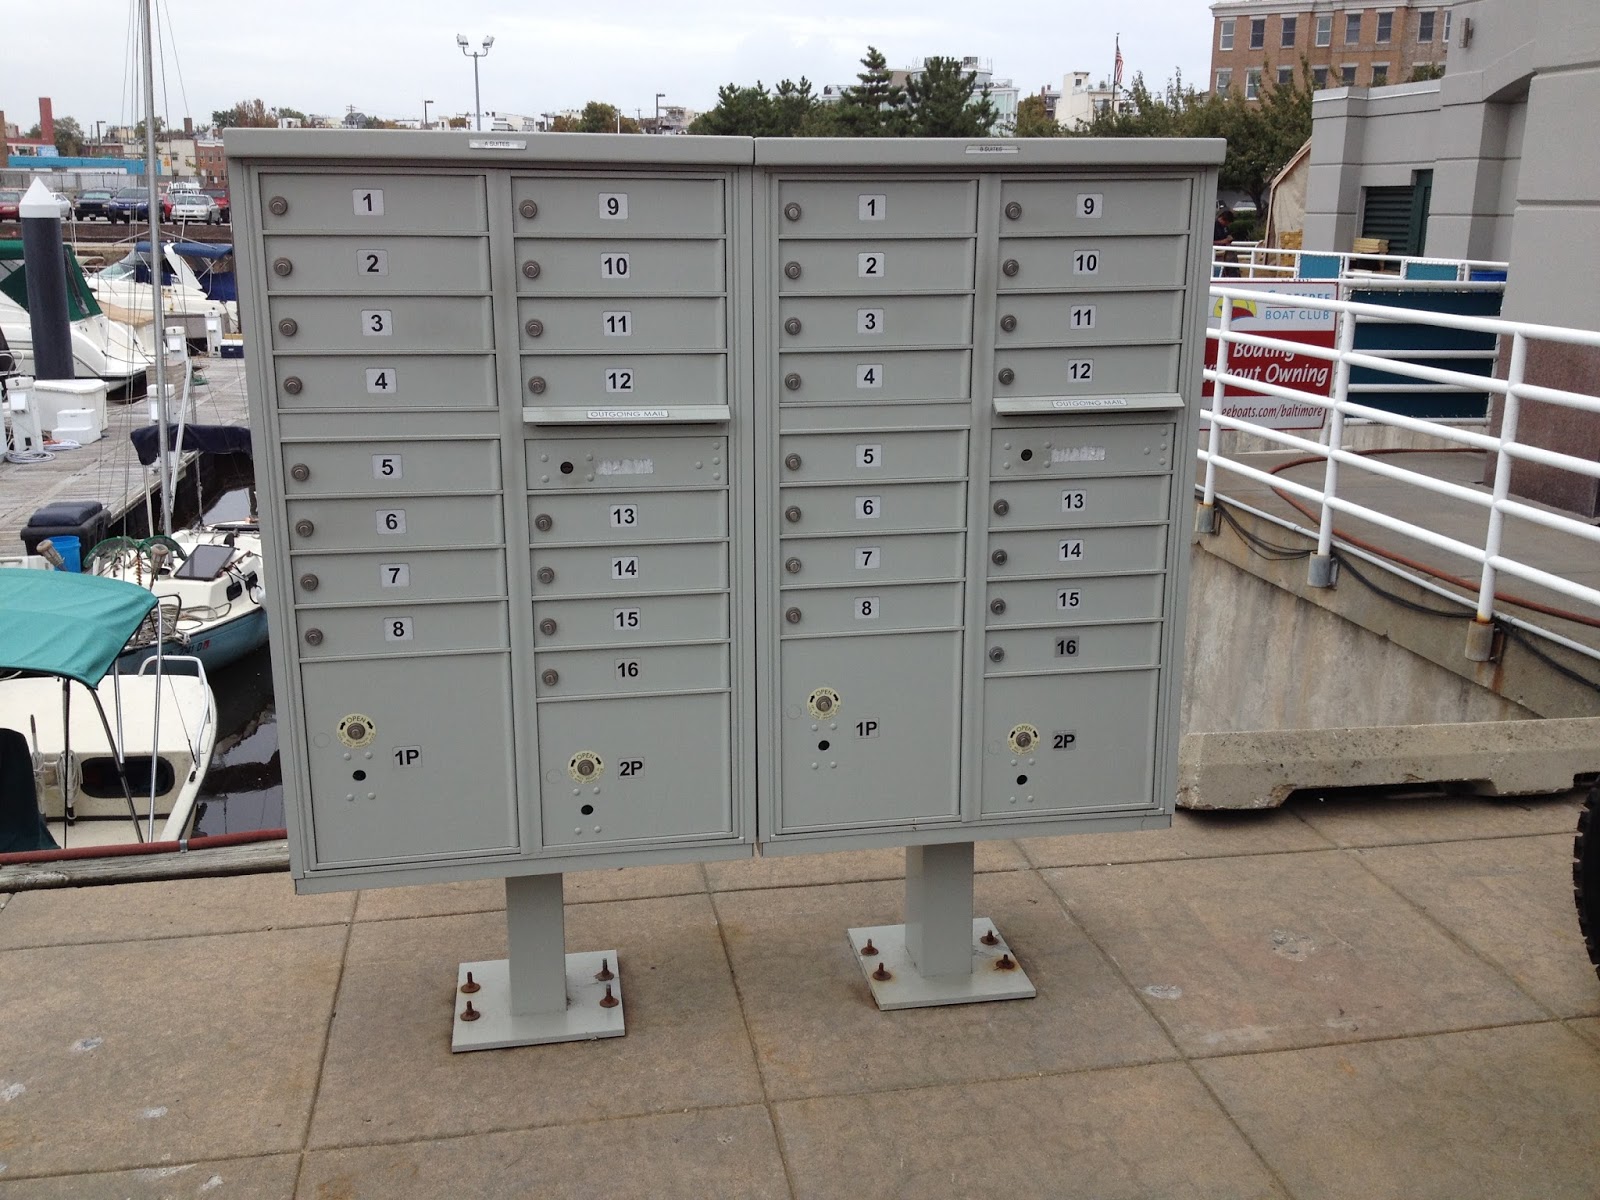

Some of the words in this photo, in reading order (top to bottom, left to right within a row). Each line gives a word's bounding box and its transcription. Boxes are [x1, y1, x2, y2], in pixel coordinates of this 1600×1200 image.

[362, 193, 373, 212] 1
[607, 197, 619, 216] 9
[867, 198, 876, 217] 1
[1083, 197, 1095, 215] 9
[366, 254, 380, 273] 2
[604, 257, 628, 276] 10
[865, 256, 877, 274] 2
[1076, 254, 1097, 272] 10
[370, 314, 384, 332] 3
[864, 312, 876, 330] 3
[1073, 309, 1092, 326] 11
[1265, 310, 1295, 320] BOAT
[1298, 310, 1330, 320] CLUB
[606, 315, 627, 333] 11
[863, 367, 876, 385] 4
[1070, 362, 1091, 380] 12
[1265, 363, 1329, 387] Owning
[374, 372, 388, 390] 4
[608, 372, 632, 390] 12
[863, 448, 874, 465] 5
[381, 458, 394, 476] 5
[862, 499, 874, 516] 6
[1064, 493, 1084, 509] 13
[385, 513, 398, 530] 6
[613, 508, 635, 525] 13
[862, 550, 873, 566] 7
[1061, 542, 1082, 558] 14
[388, 567, 401, 584] 7
[614, 559, 637, 576] 14
[1059, 591, 1080, 607] 15
[861, 600, 872, 616] 8
[616, 611, 639, 628] 15
[392, 621, 405, 638] 8
[1056, 639, 1077, 655] 16
[617, 661, 639, 678] 16
[815, 689, 833, 697] OPEN
[346, 715, 366, 723] OPEN
[855, 721, 878, 737] 1P
[1016, 725, 1033, 733] OPEN
[1052, 733, 1076, 750] 2P
[394, 749, 420, 766] 1P
[576, 752, 595, 760] OPEN
[619, 760, 644, 777] 2P
